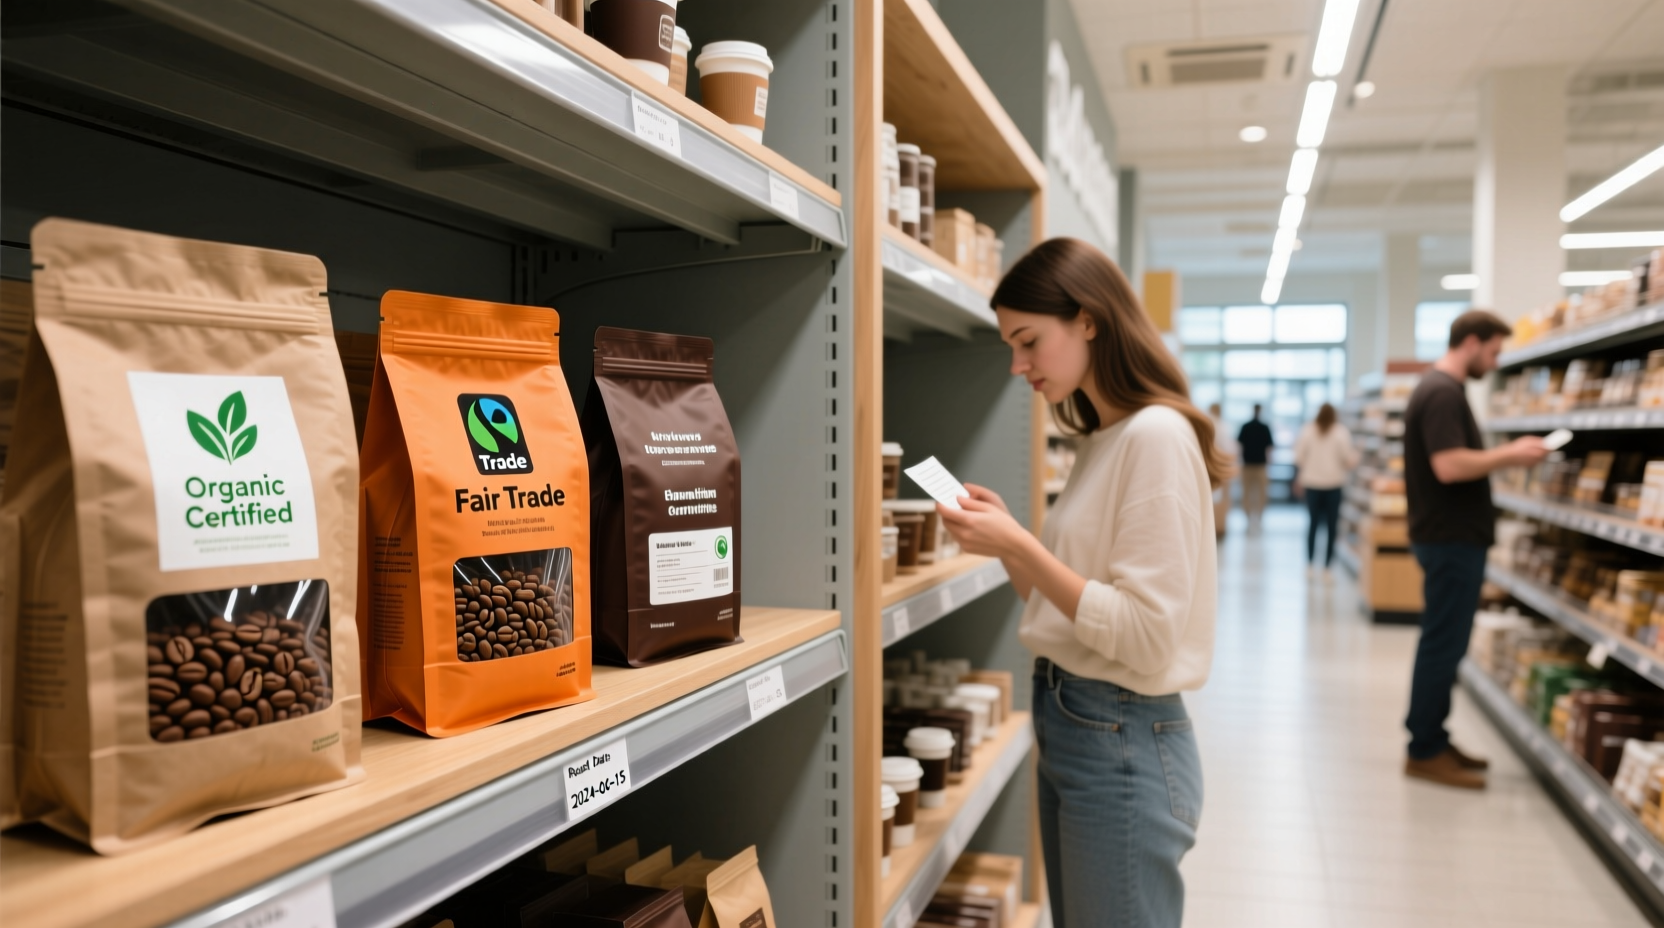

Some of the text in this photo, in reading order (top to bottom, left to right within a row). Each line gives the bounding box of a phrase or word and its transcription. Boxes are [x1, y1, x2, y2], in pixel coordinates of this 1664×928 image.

[478, 452, 528, 471] Trade
[184, 473, 286, 504] Organic
[455, 483, 566, 514] Fair Trade
[185, 500, 293, 529] Certified
